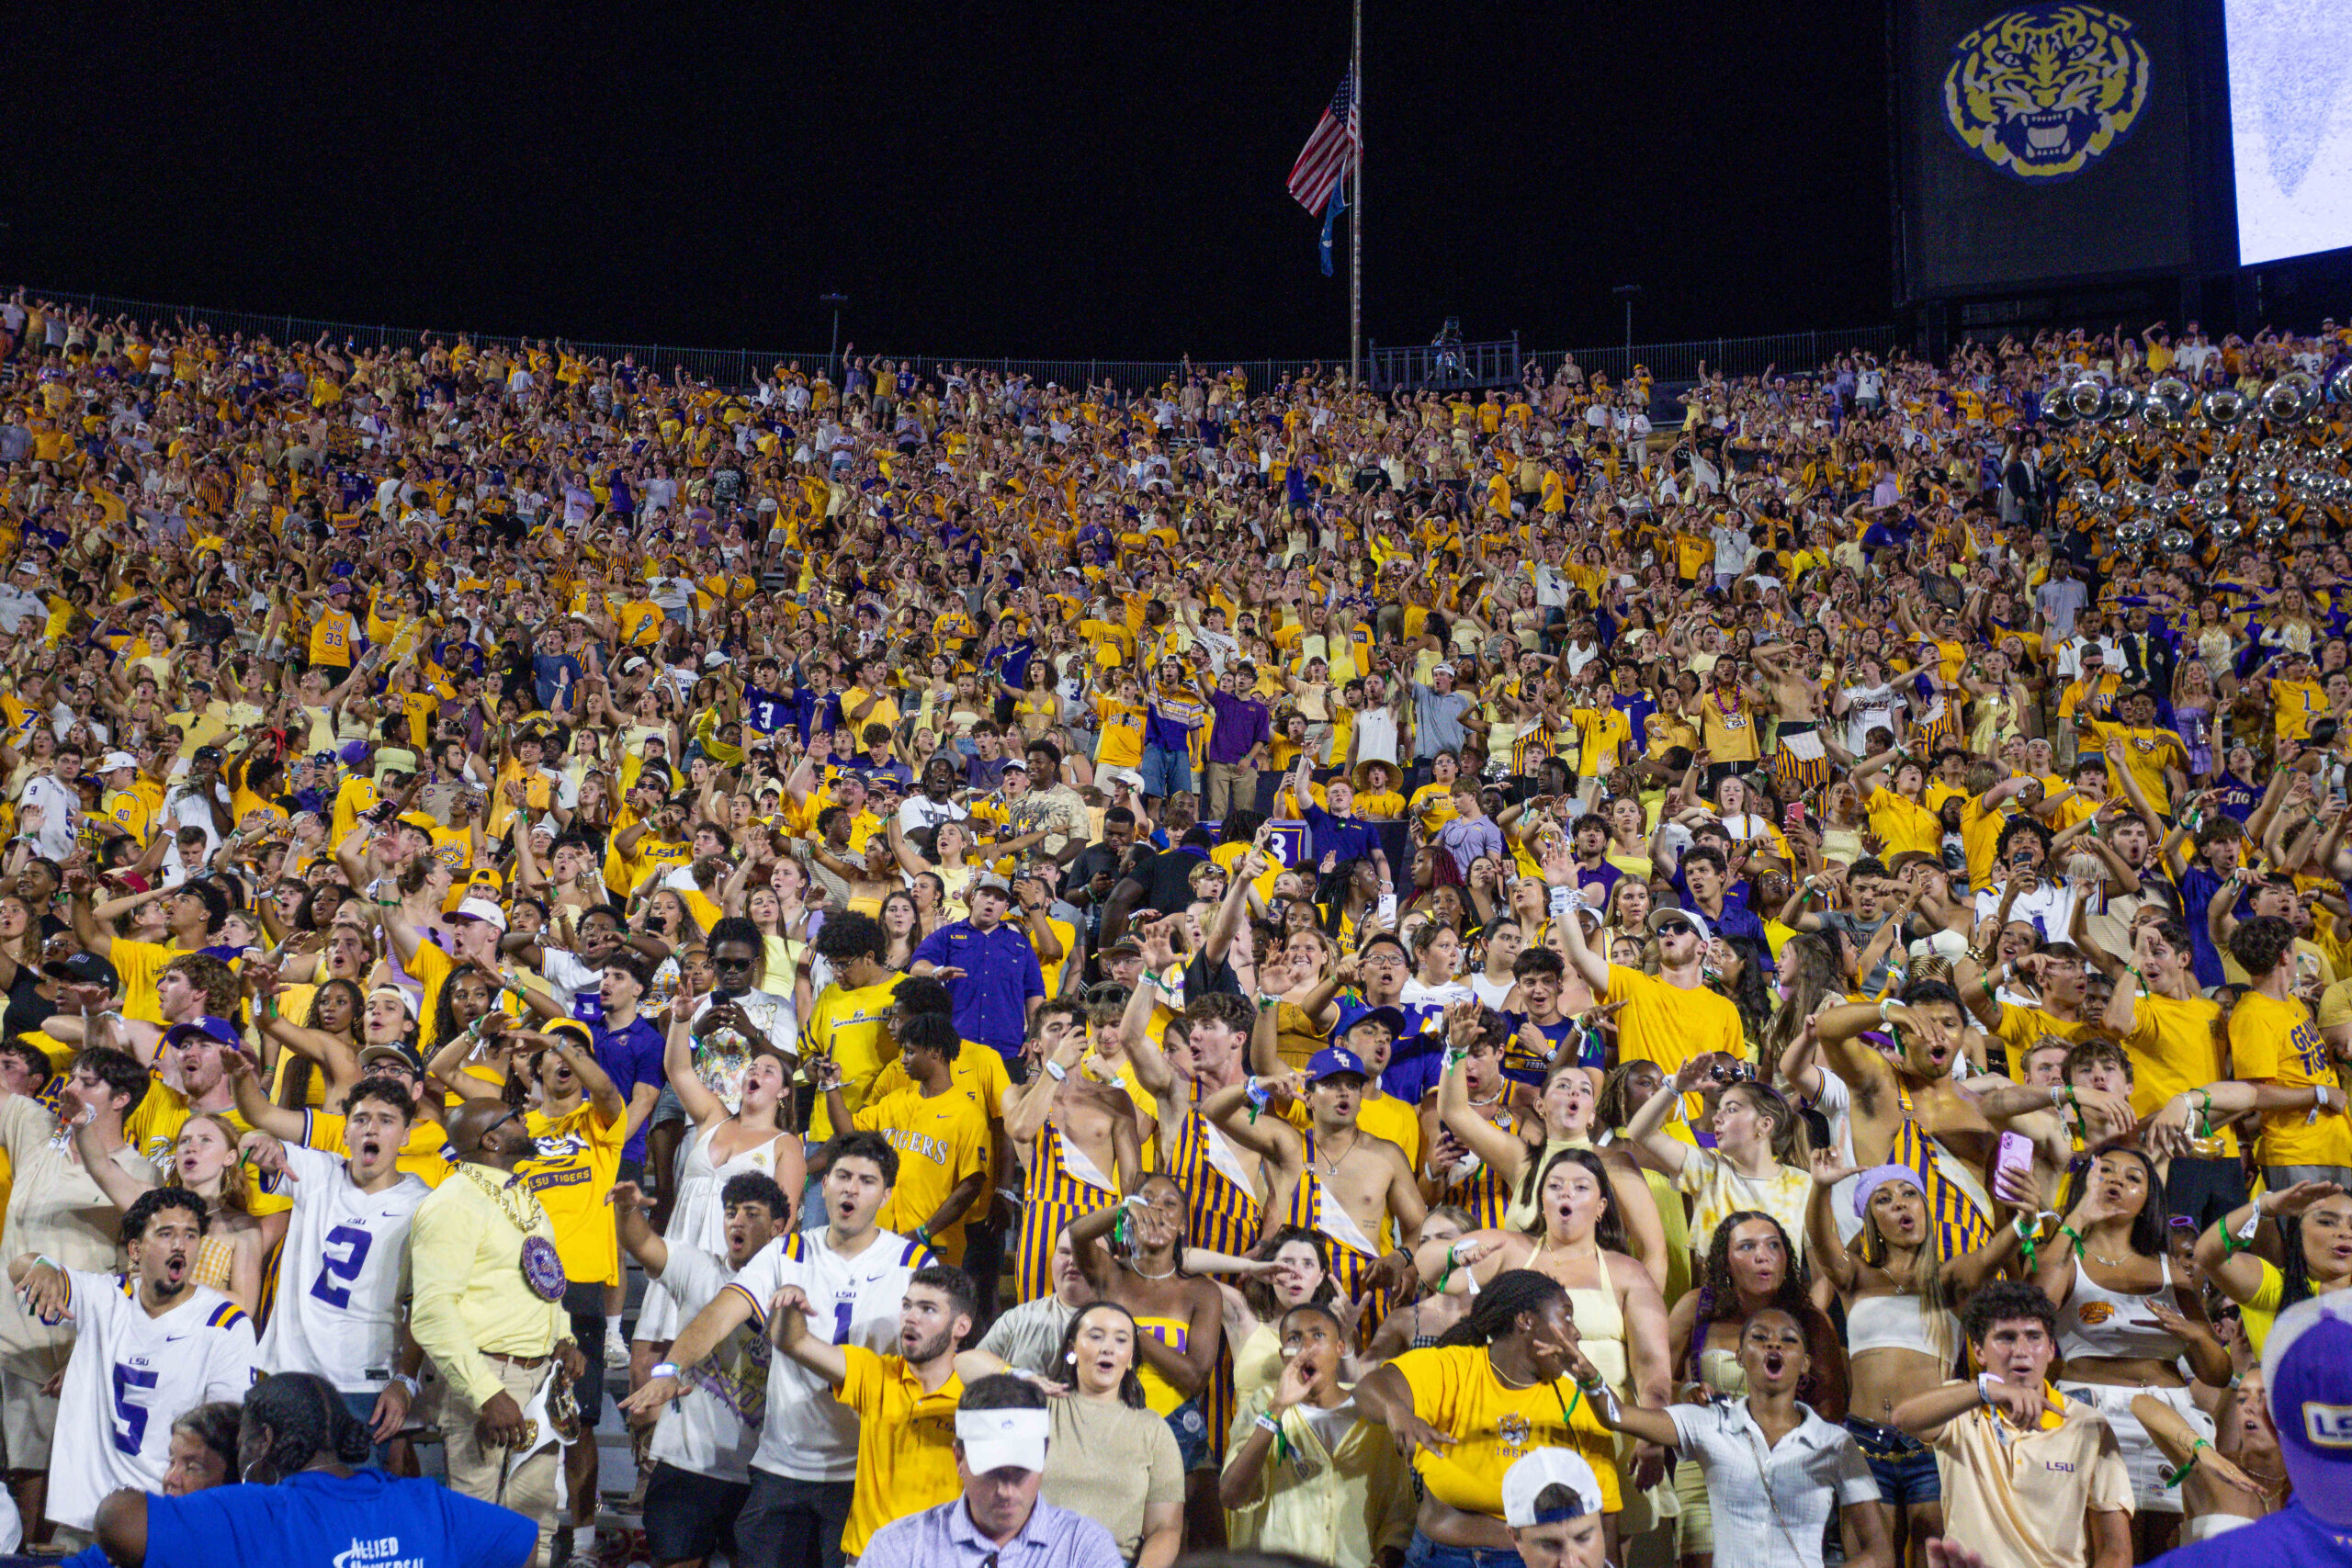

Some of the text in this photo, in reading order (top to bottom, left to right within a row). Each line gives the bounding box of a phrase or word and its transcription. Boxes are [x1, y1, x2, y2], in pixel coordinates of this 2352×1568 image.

[436, 486, 447, 499] 7
[327, 620, 344, 632] LSU
[324, 633, 343, 647] 33
[1850, 696, 1890, 712] Tigers
[2303, 690, 2311, 712] 1
[20, 708, 40, 730] 7
[758, 702, 775, 729] 3
[29, 785, 39, 796] 9
[366, 786, 373, 799] 7
[116, 808, 130, 822] 40
[644, 845, 685, 858] LSU
[2290, 1021, 2322, 1053] GEAU
[1332, 1049, 1351, 1068] LSU
[882, 1127, 948, 1166] TIGERS
[529, 1169, 590, 1190] LSU TIGERS
[345, 1217, 367, 1226] LSU
[310, 1225, 373, 1311] 2
[835, 1291, 856, 1300] LSU
[832, 1303, 854, 1347] 1
[128, 1357, 150, 1367] LSU
[112, 1362, 160, 1458] 5
[2045, 1461, 2075, 1473] LSU
[351, 1536, 400, 1560] ALLIED
